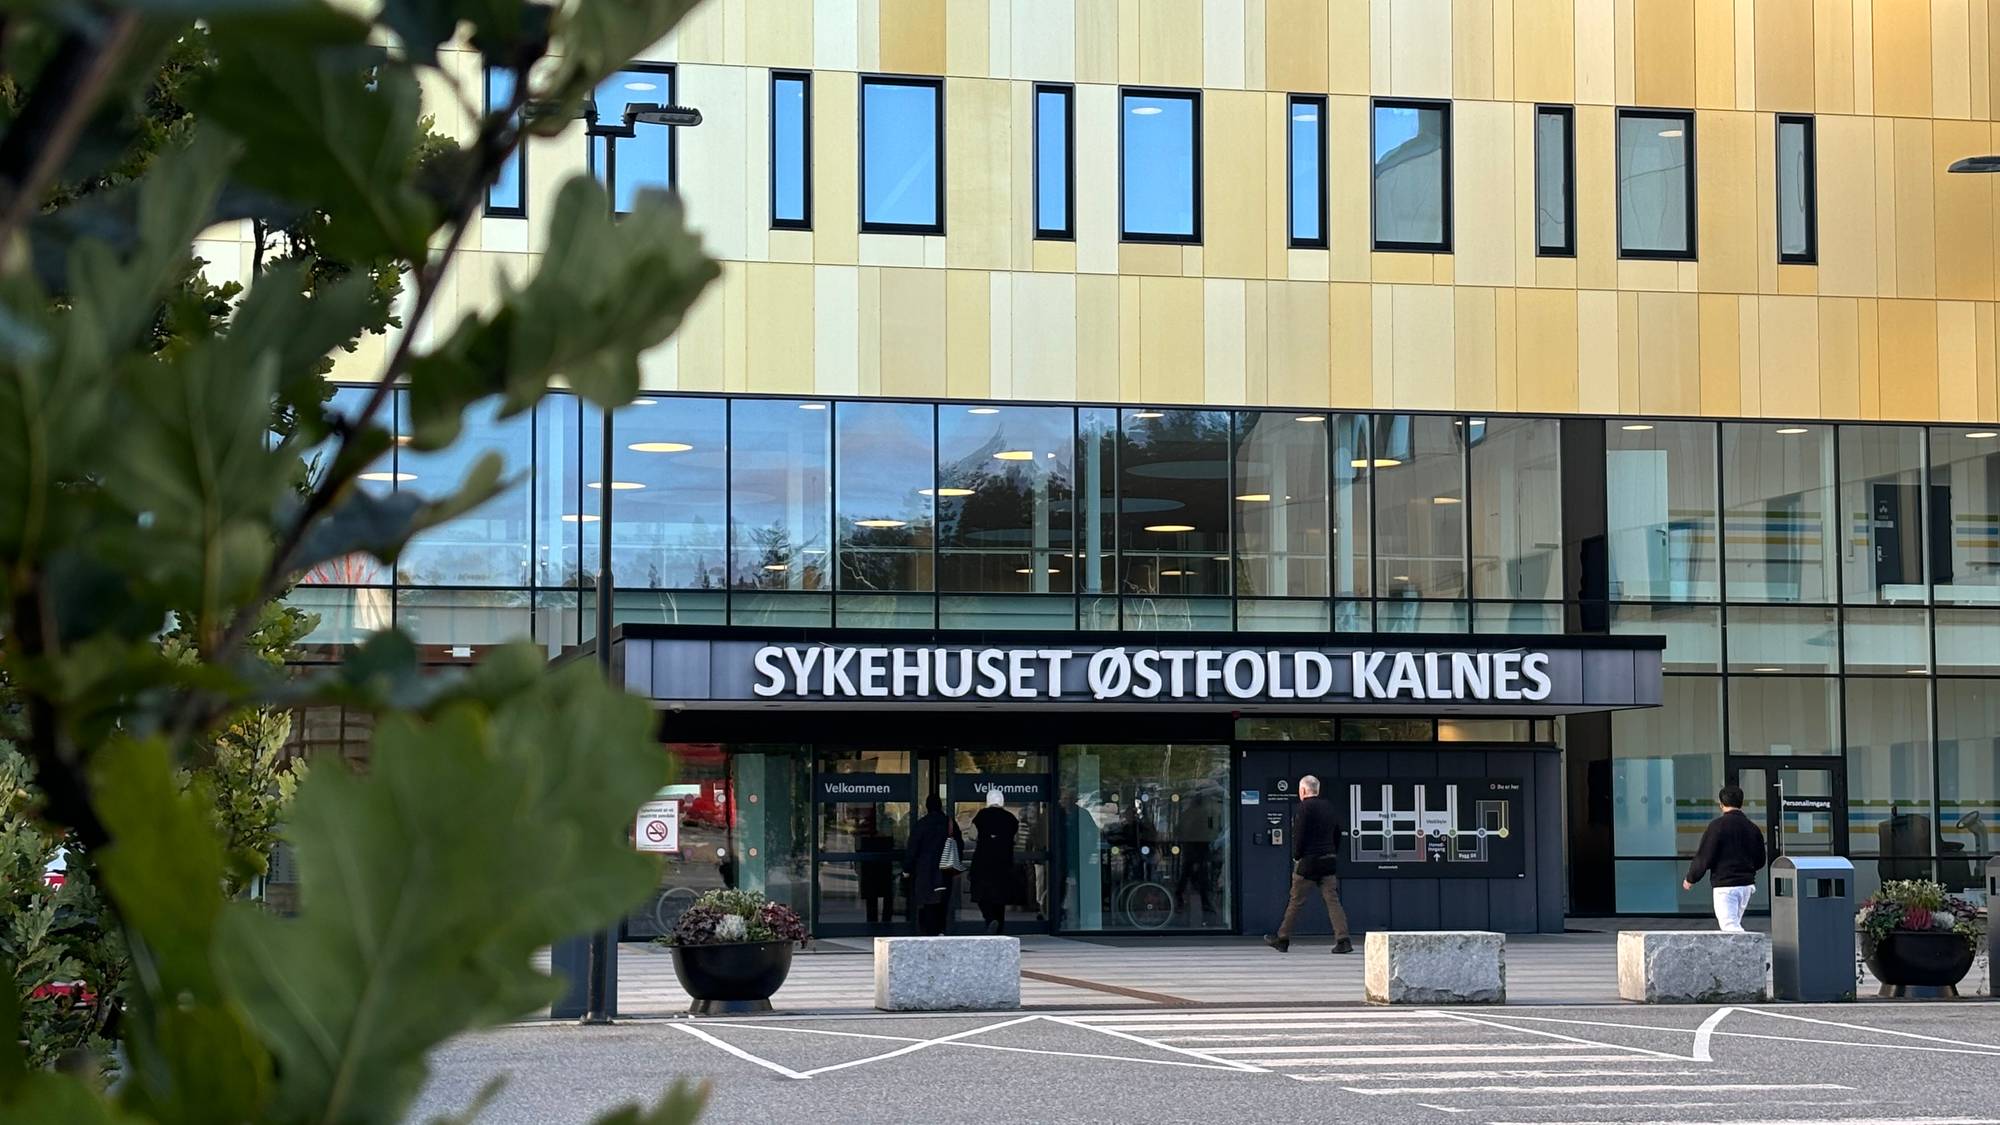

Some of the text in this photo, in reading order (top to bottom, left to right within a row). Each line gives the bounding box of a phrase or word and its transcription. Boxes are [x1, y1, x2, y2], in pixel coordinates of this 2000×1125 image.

[753, 646, 1552, 700] SYKEHUSET ØSTFOLD KALNES
[824, 782, 890, 793] Velkommen
[973, 782, 1039, 793] Velkommen
